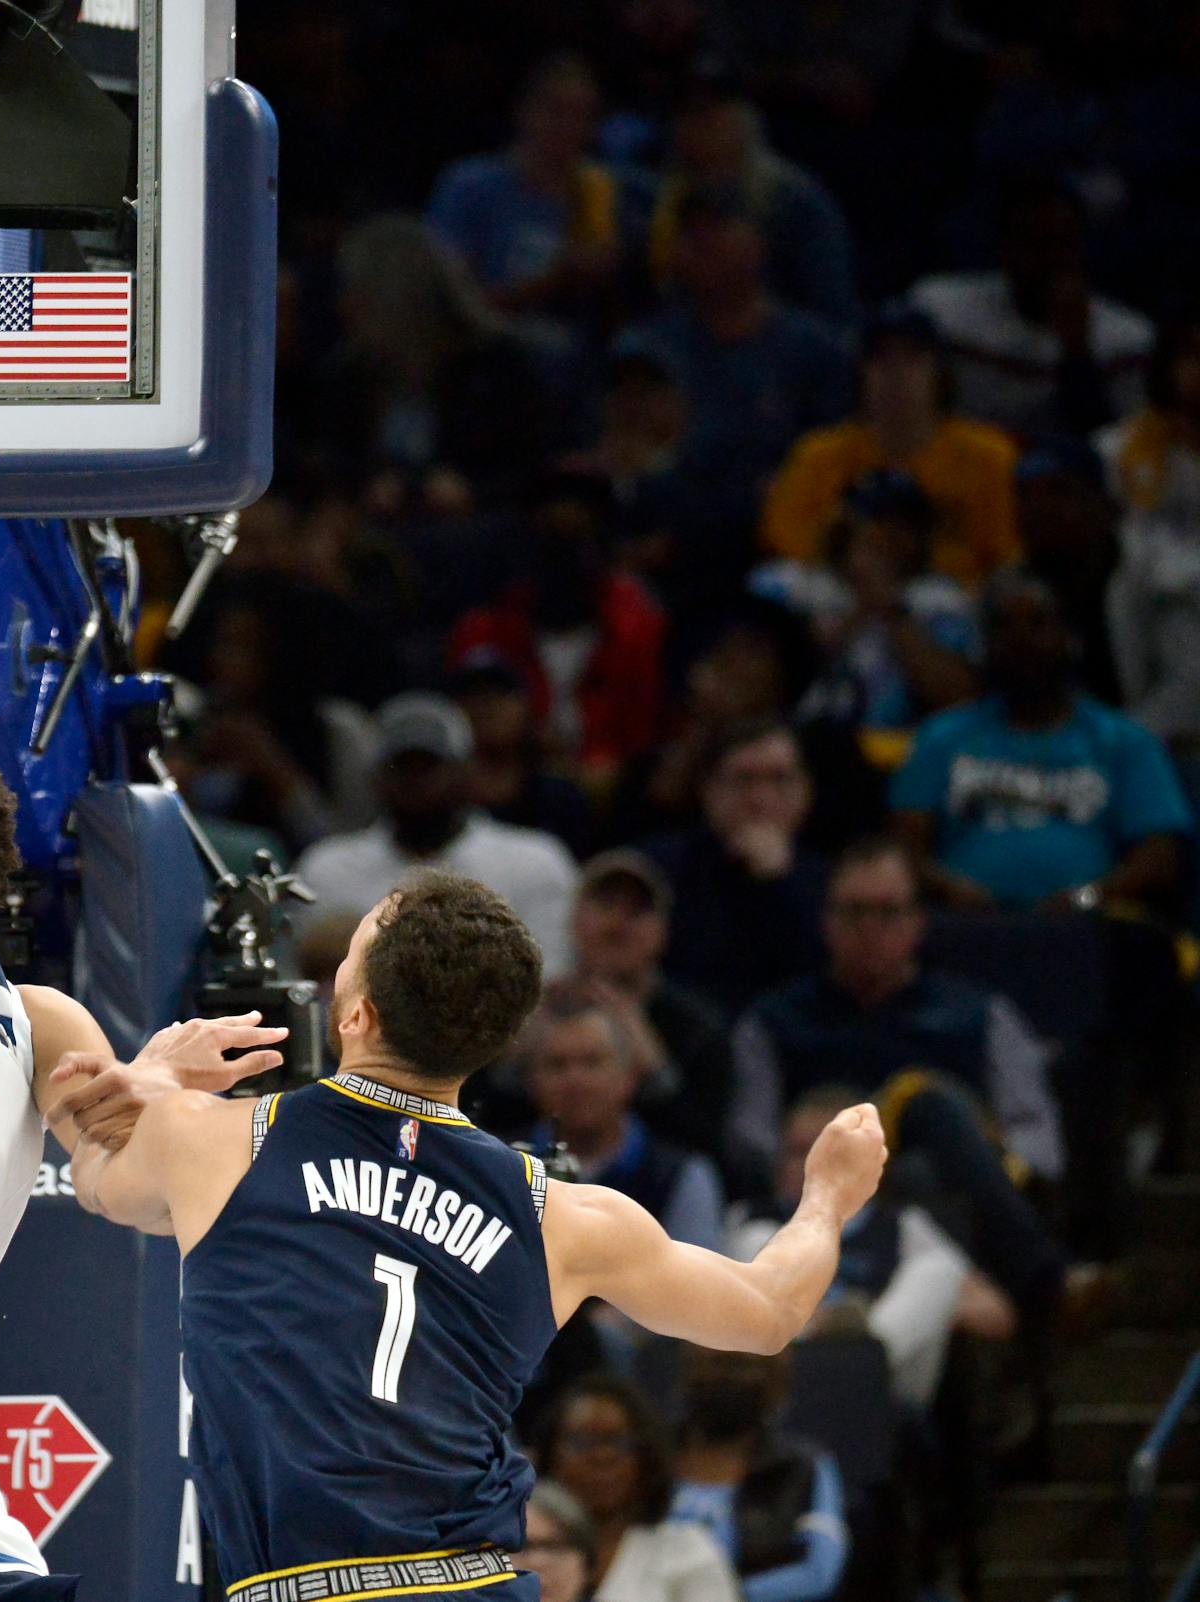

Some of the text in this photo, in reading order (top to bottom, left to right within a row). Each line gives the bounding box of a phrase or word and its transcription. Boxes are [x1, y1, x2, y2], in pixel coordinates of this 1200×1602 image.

[301, 1158, 513, 1274] ANDERSON
[371, 1252, 419, 1404] 1
[6, 1428, 53, 1490] 75
